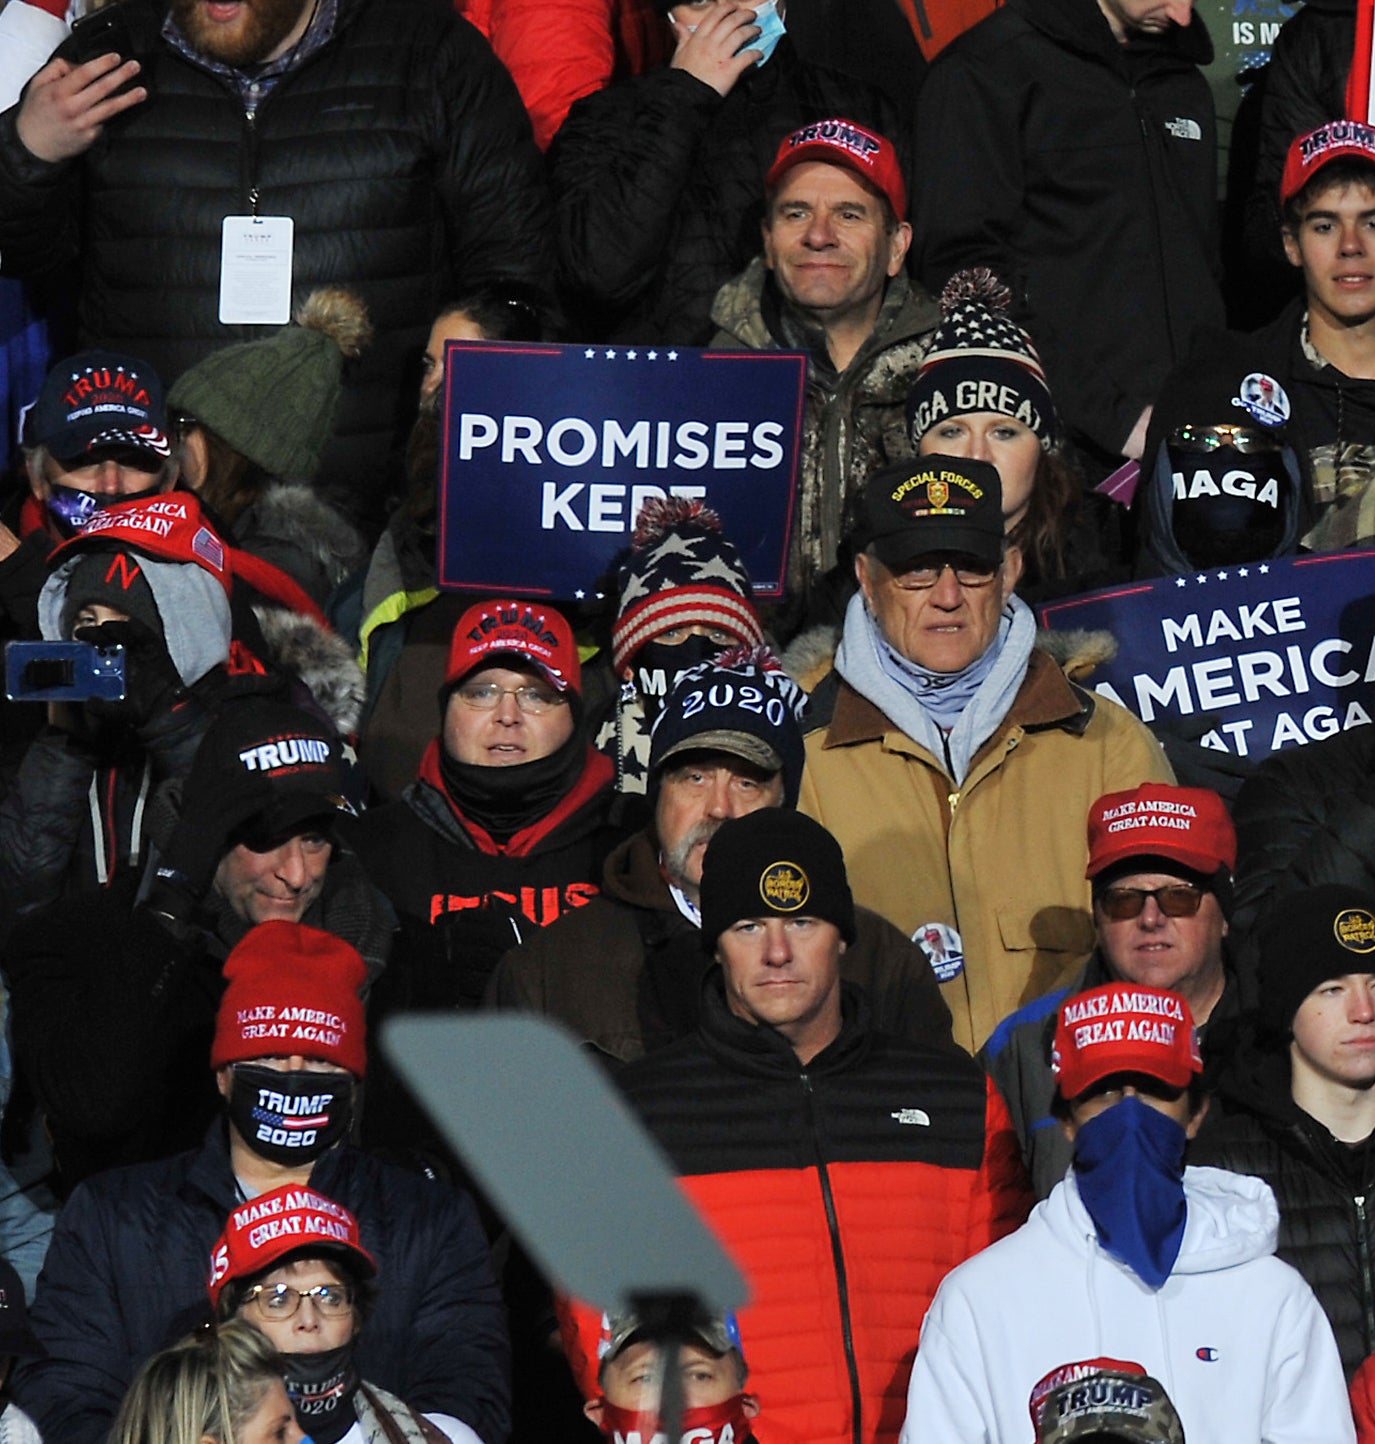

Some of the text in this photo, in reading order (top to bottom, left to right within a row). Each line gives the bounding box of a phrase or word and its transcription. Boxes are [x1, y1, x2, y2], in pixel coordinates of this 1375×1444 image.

[1233, 22, 1283, 44] IS M
[789, 124, 881, 154] TRUMP
[64, 370, 151, 406] TRUMP
[459, 413, 784, 470] PROMISES
[892, 471, 984, 502] SPECIAL FORCES
[105, 553, 140, 590] N
[467, 609, 559, 648] TRUMP
[1162, 596, 1306, 653] MAKE
[682, 684, 784, 726] 2020
[239, 739, 330, 771] TRUMP
[1102, 799, 1197, 822] MAKE AMERICA
[1108, 814, 1190, 833] GREAT AGAIN
[238, 1005, 348, 1032] MAKE AMERICA
[1065, 992, 1183, 1026] MAKE AMERICA
[242, 1024, 342, 1046] GREAT AGAIN
[1075, 1020, 1174, 1049] GREAT AGAIN
[257, 1088, 333, 1116] TRUMP
[256, 1125, 317, 1148] 2020
[234, 1191, 352, 1231] MAKE AMERICA
[248, 1216, 349, 1249] GREAT AGAIN
[300, 1396, 337, 1415] 020
[1058, 1383, 1153, 1416] TRUMP
